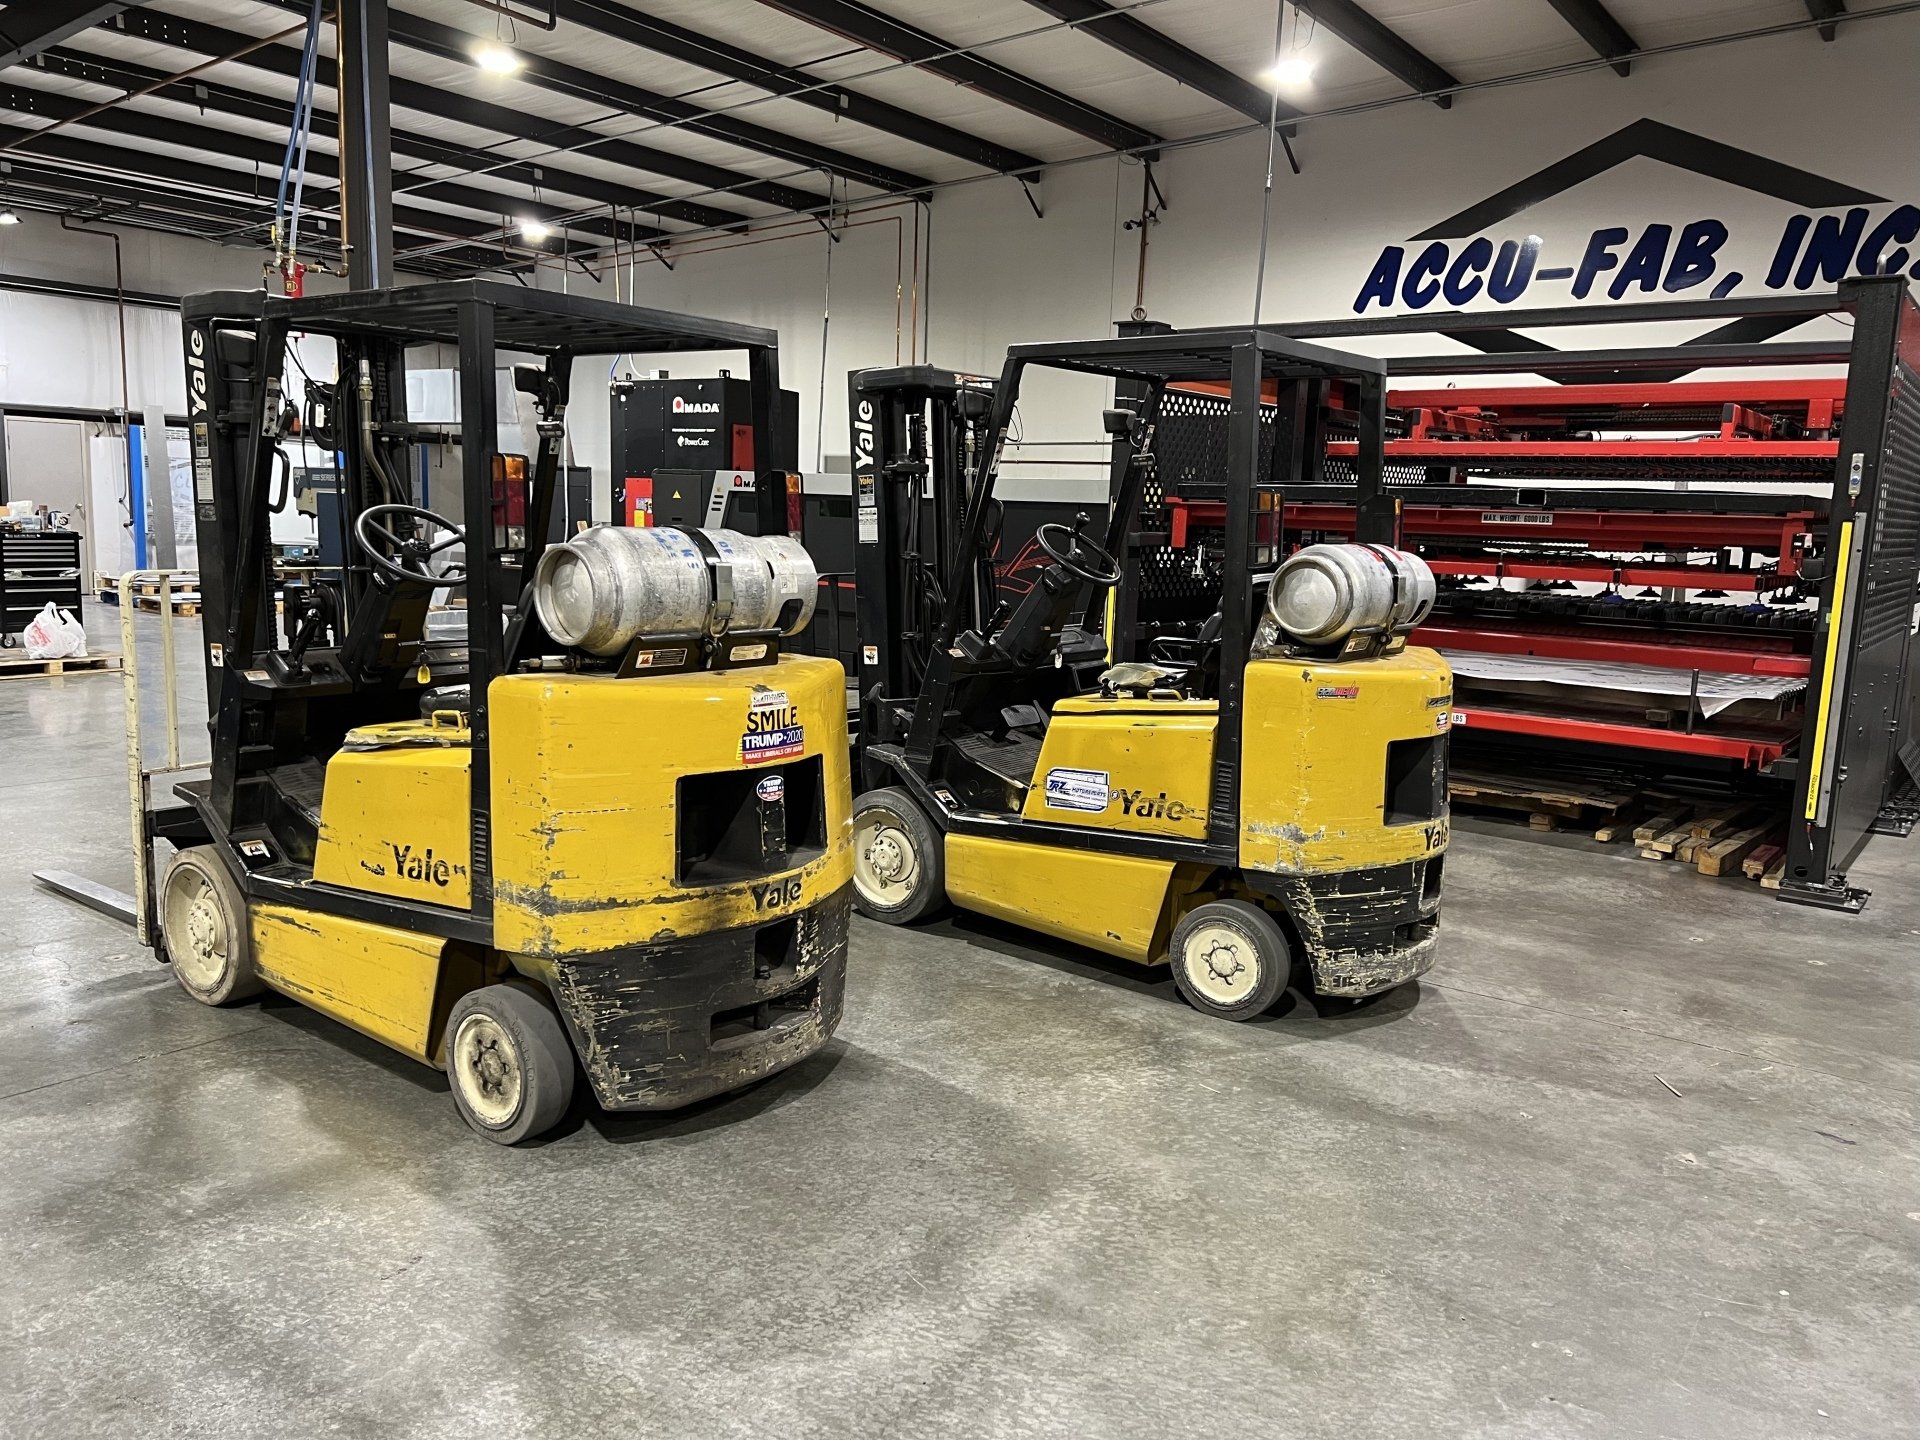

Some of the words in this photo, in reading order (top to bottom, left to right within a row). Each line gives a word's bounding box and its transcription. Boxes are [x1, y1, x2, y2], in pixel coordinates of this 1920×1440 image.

[1353, 218, 1743, 315] ACCU-FAB,
[188, 329, 207, 416] Yale
[672, 396, 720, 413] AMADA
[854, 400, 874, 470] Yale
[734, 475, 756, 488] AMA
[747, 706, 798, 733] SMILE
[743, 733, 783, 748] TRUMP
[786, 729, 804, 743] 2020
[1119, 788, 1187, 821] Yale
[1424, 823, 1449, 852] Yale
[392, 844, 450, 887] Yale
[752, 878, 803, 912] Yale
